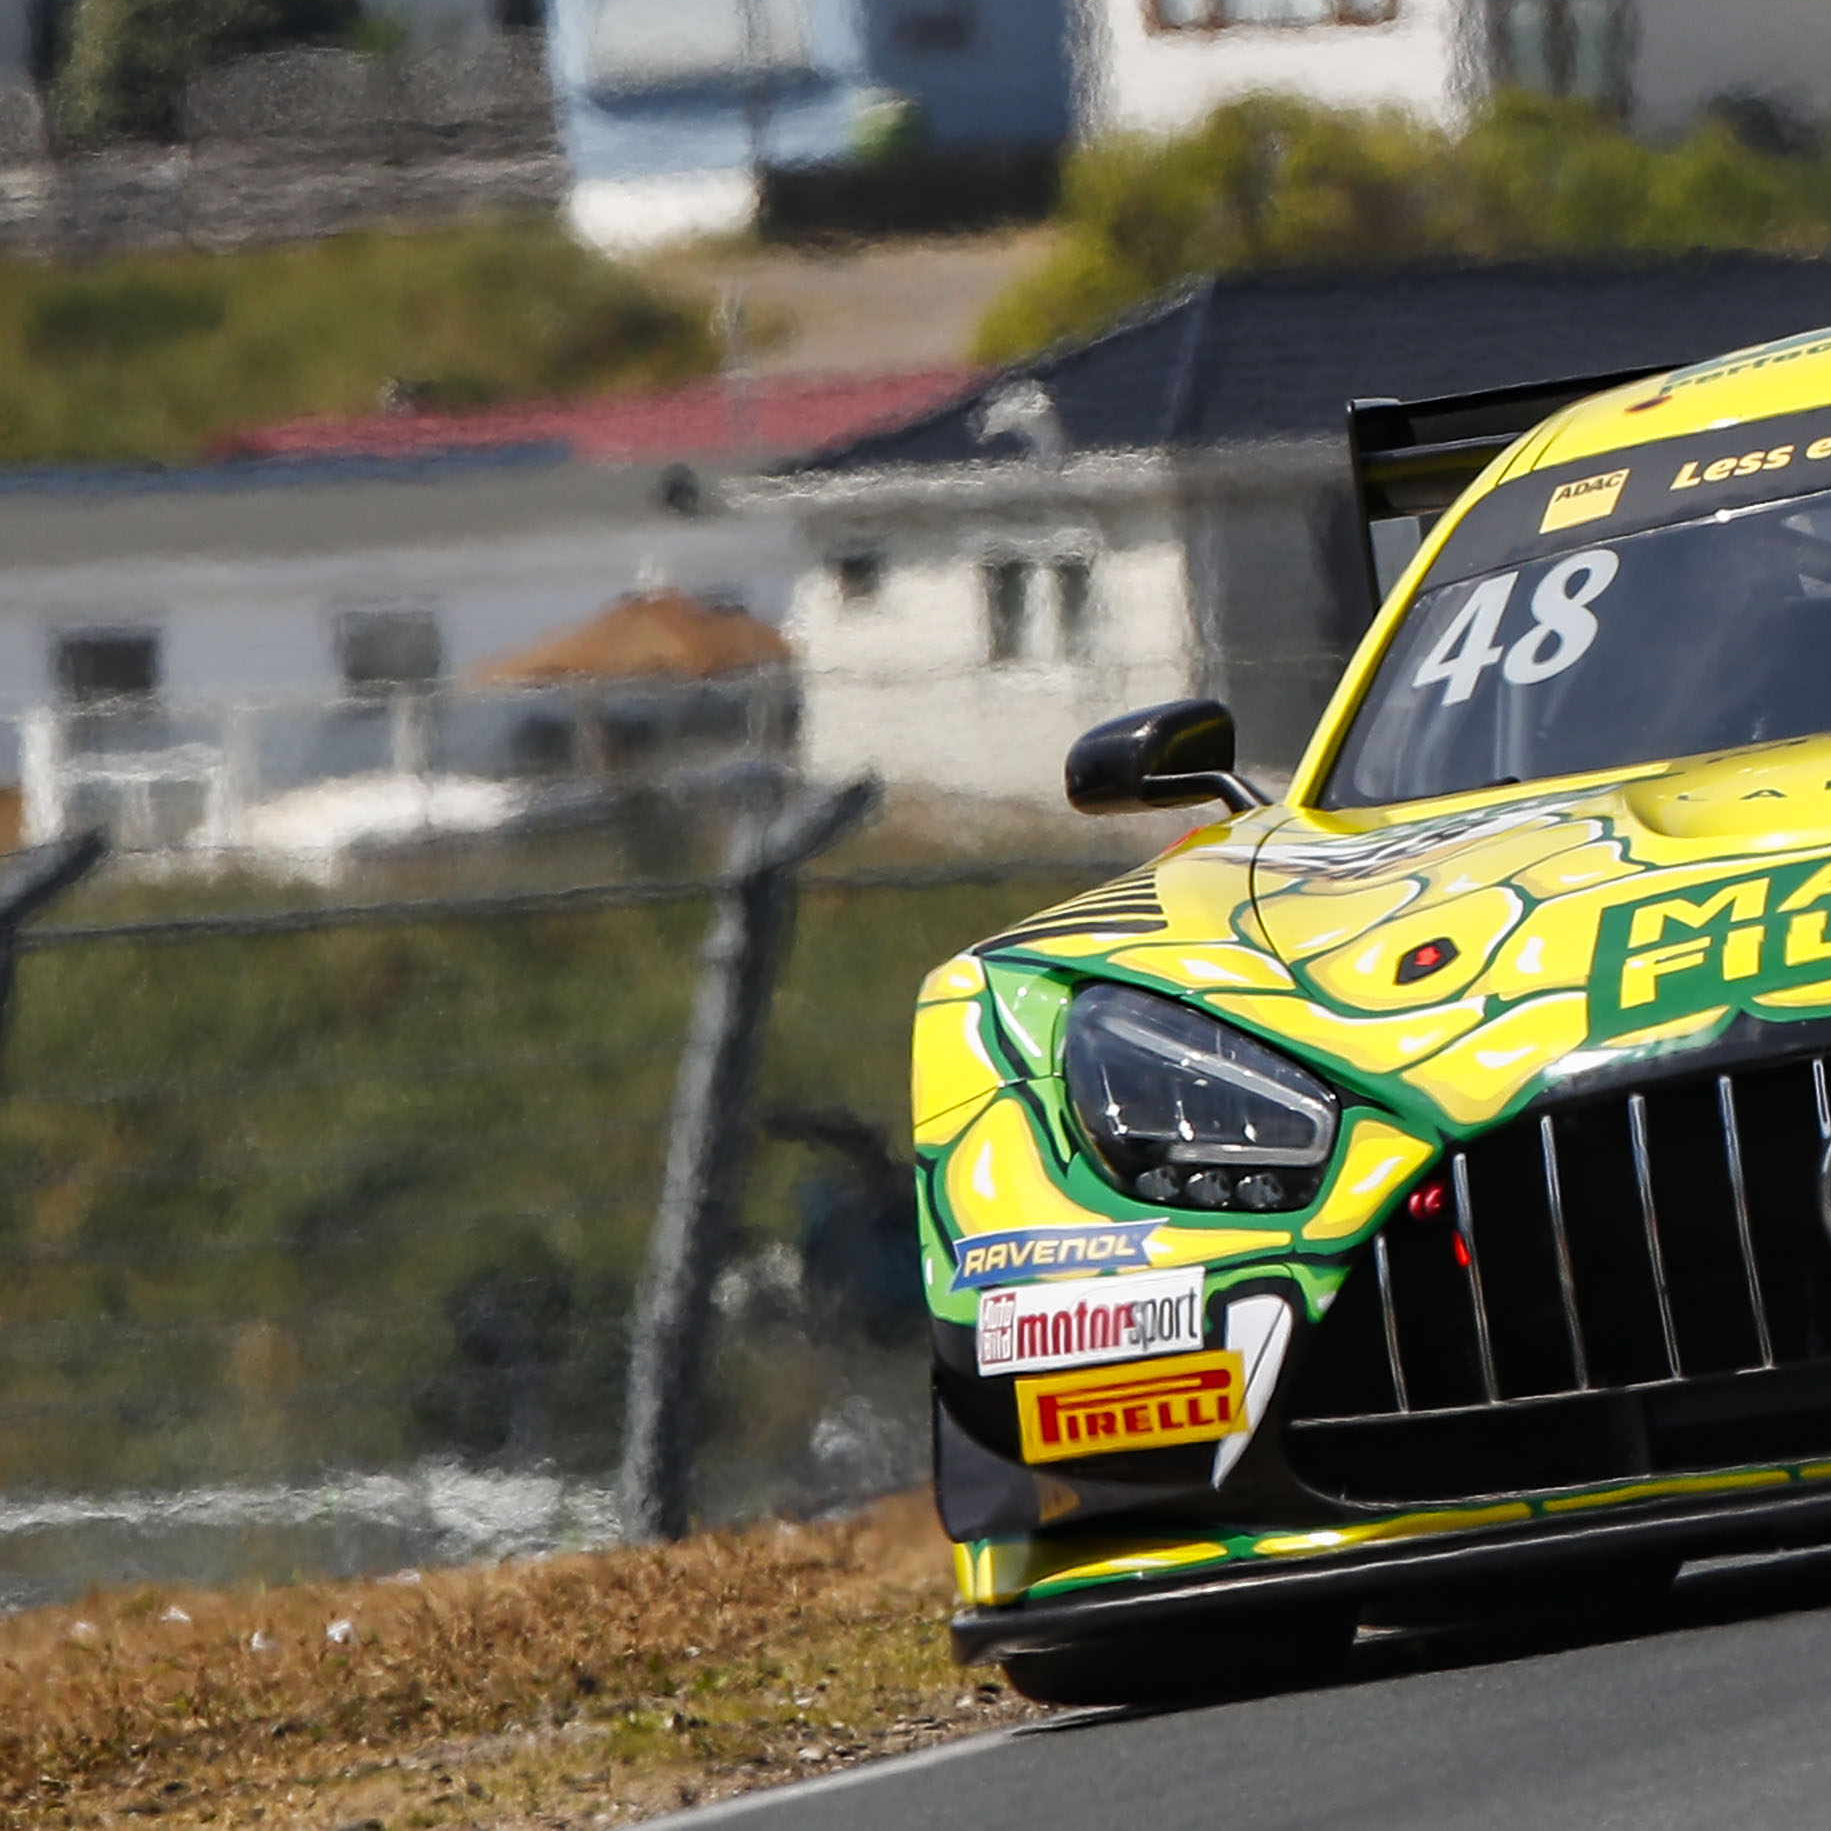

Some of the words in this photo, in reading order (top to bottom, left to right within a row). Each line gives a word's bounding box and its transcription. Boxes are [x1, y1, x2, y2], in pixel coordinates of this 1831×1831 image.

[1554, 472, 1625, 503] ADAC
[1669, 445, 1797, 491] Less
[1411, 548, 1621, 707] 48
[964, 1233, 1138, 1278] RAVENOL
[1015, 1287, 1199, 1360] motorsport
[1036, 1368, 1232, 1446] PIRELLI
